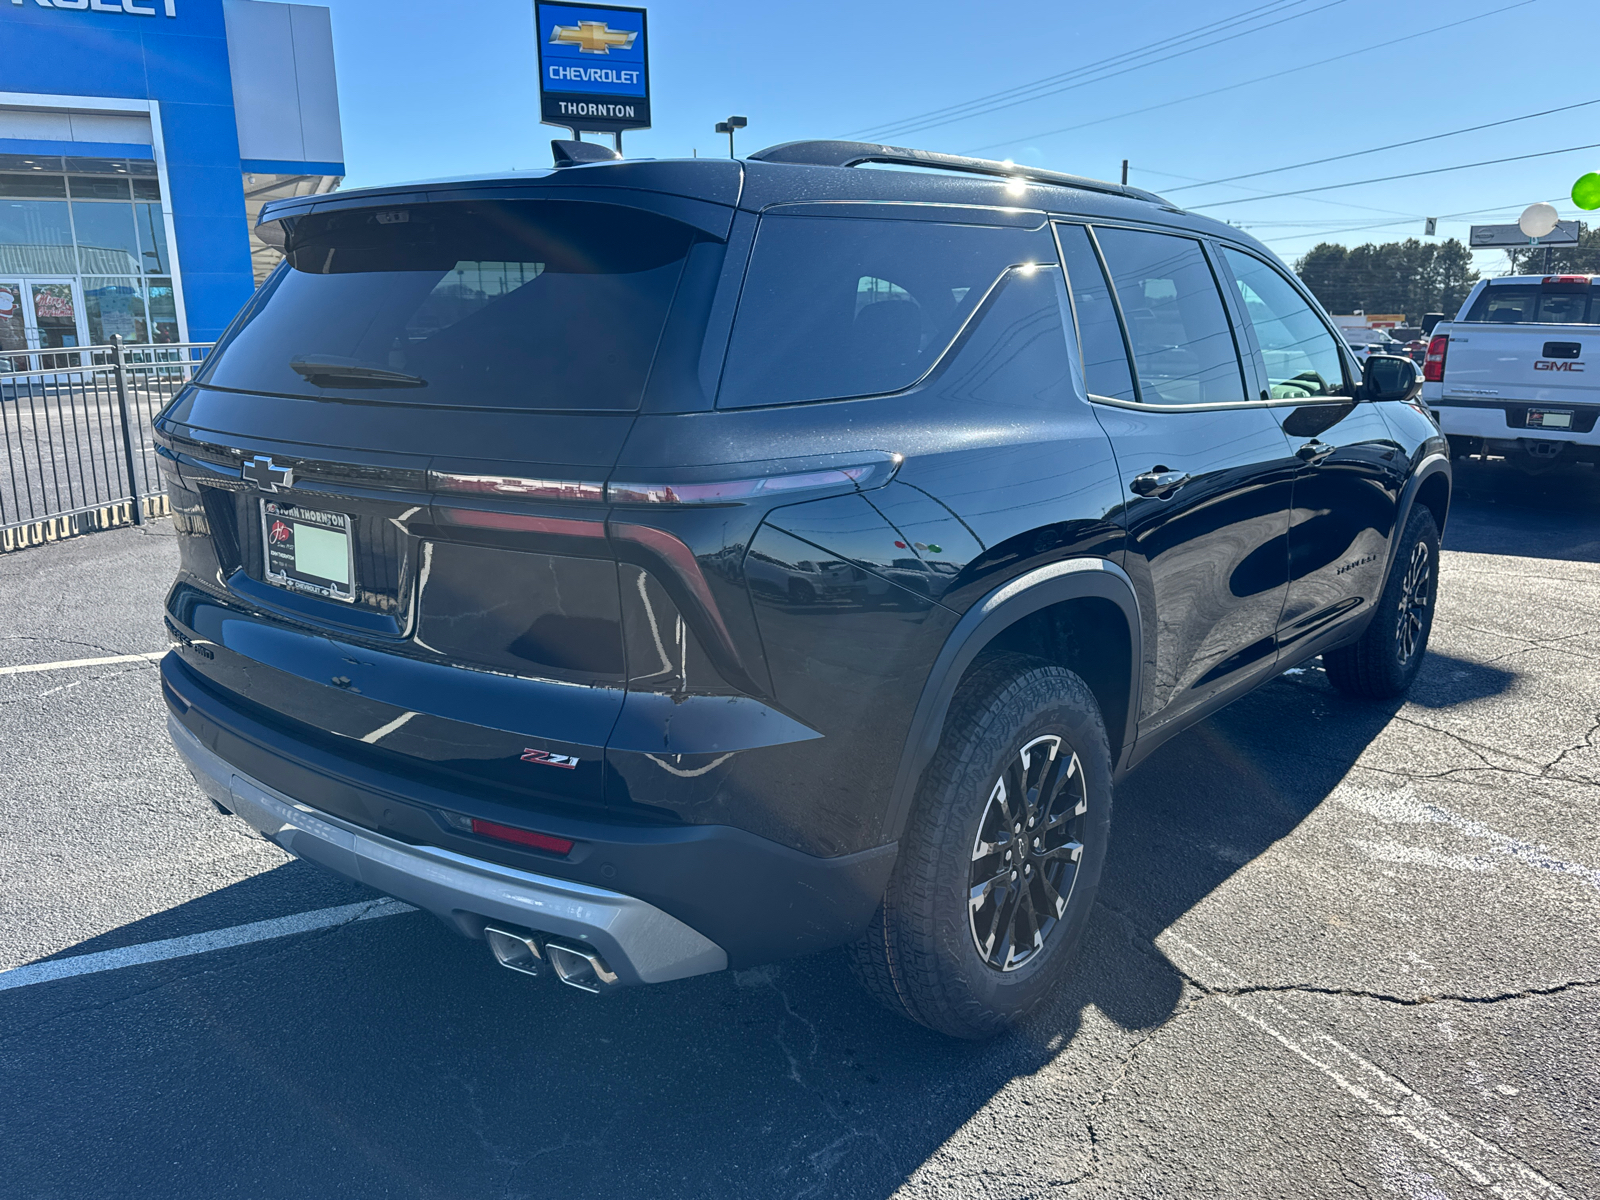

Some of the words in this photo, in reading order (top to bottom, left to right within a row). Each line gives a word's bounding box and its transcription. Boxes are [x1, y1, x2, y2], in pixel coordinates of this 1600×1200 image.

[549, 65, 640, 84] CHEVROLET
[559, 101, 635, 118] THORNTON
[35, 292, 66, 308] Merry
[1533, 360, 1586, 373] GMC
[520, 747, 581, 770] Z71
